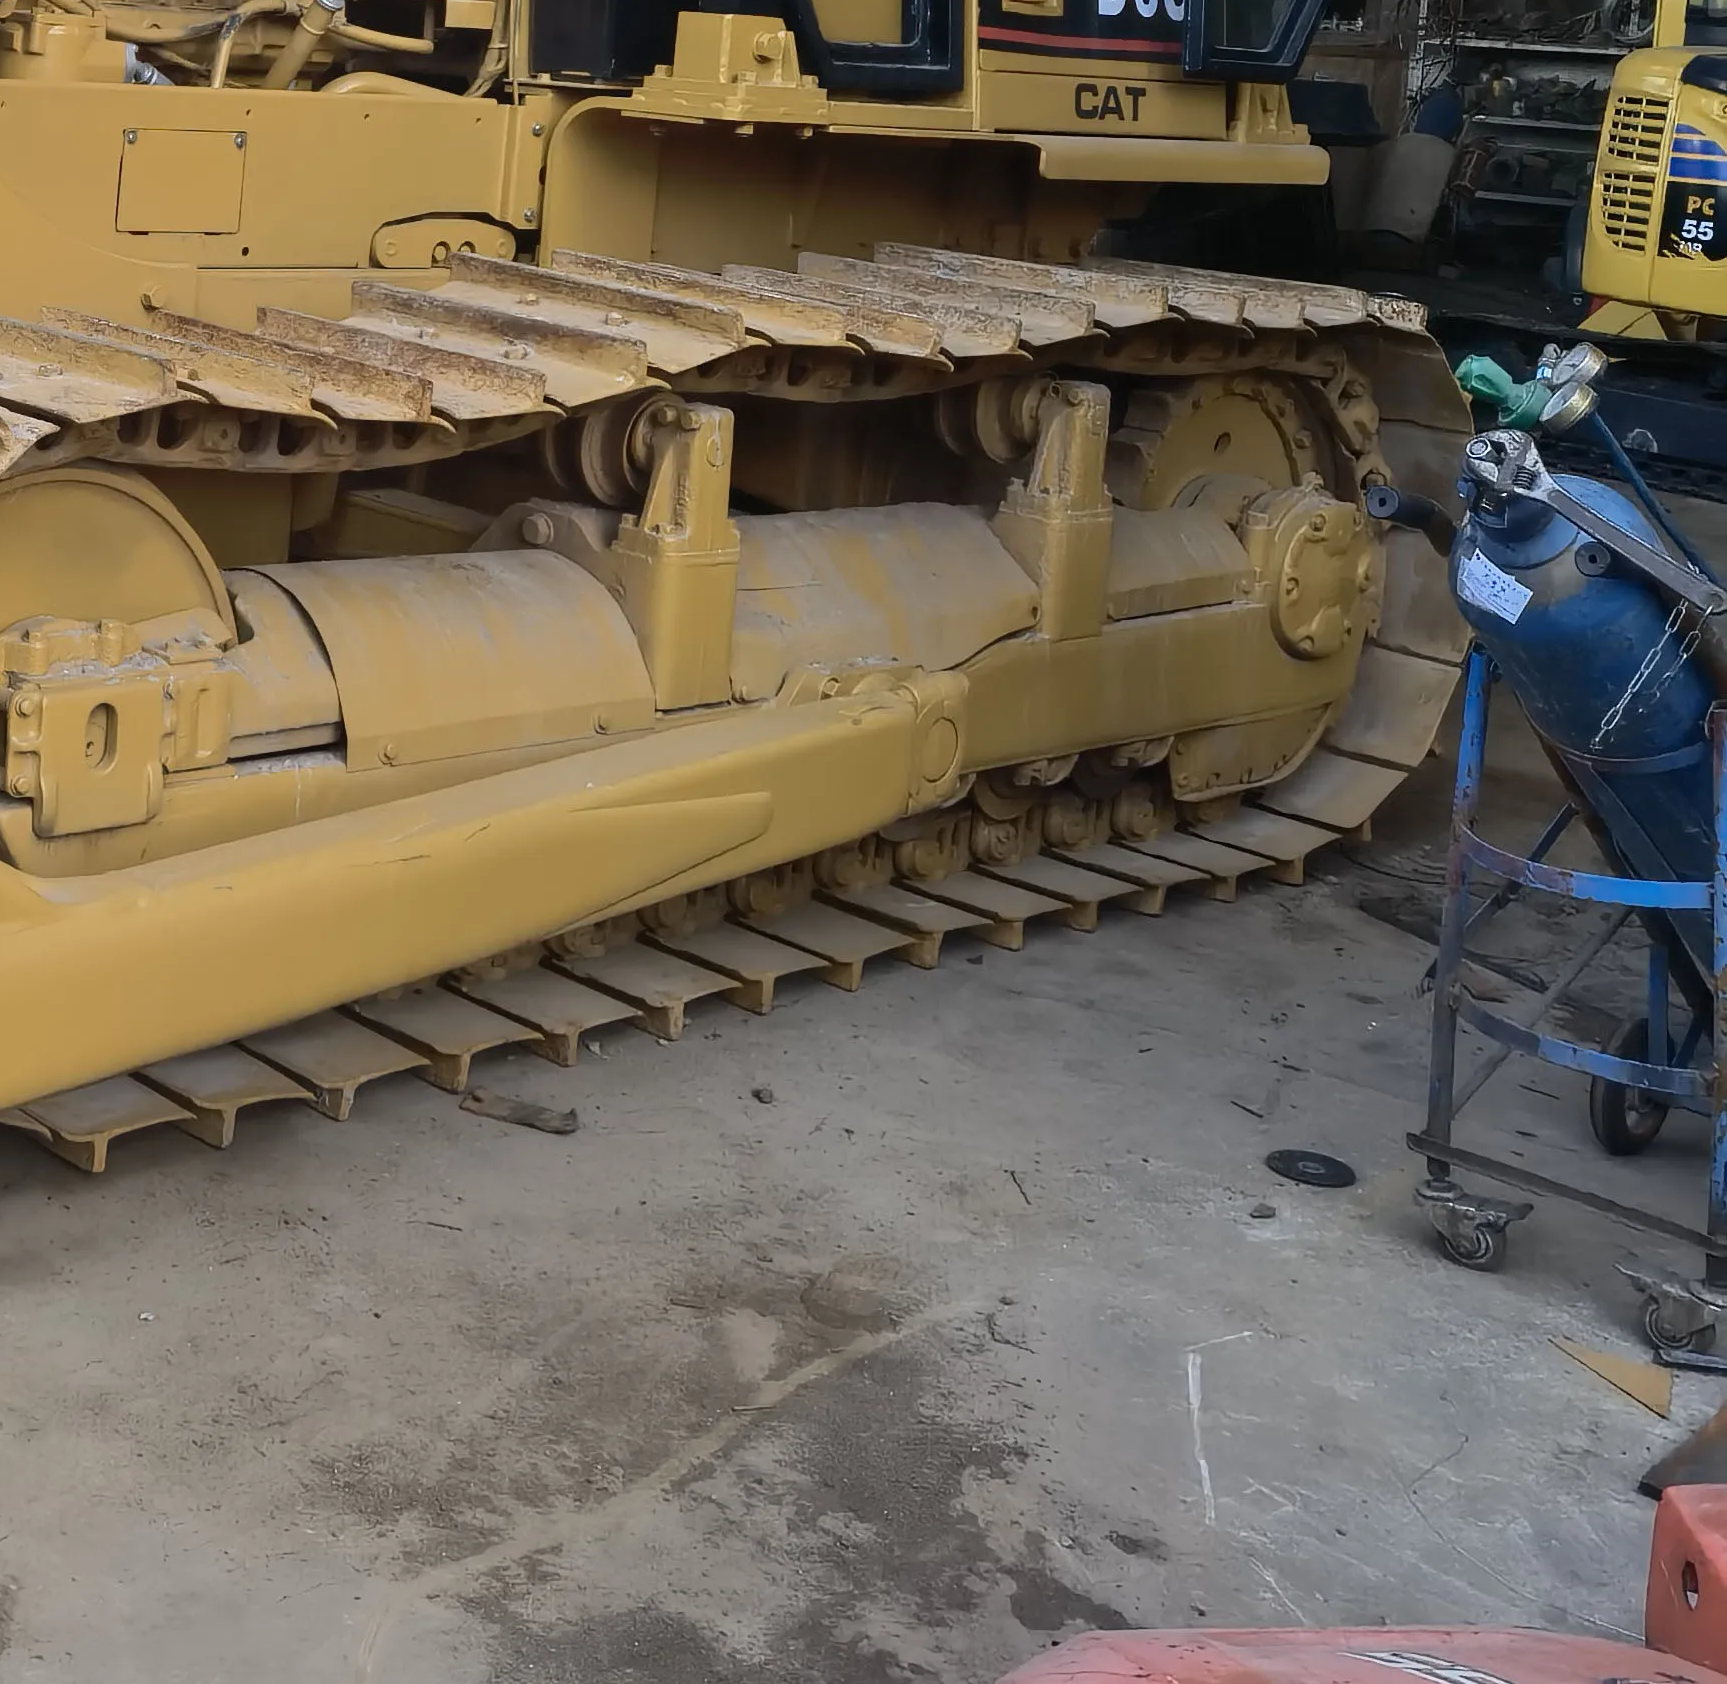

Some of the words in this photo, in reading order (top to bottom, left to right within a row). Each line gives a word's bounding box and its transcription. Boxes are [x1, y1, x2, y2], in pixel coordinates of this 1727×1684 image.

[1074, 82, 1147, 122] CAT
[1686, 195, 1716, 216] PC
[1681, 218, 1714, 241] 55
